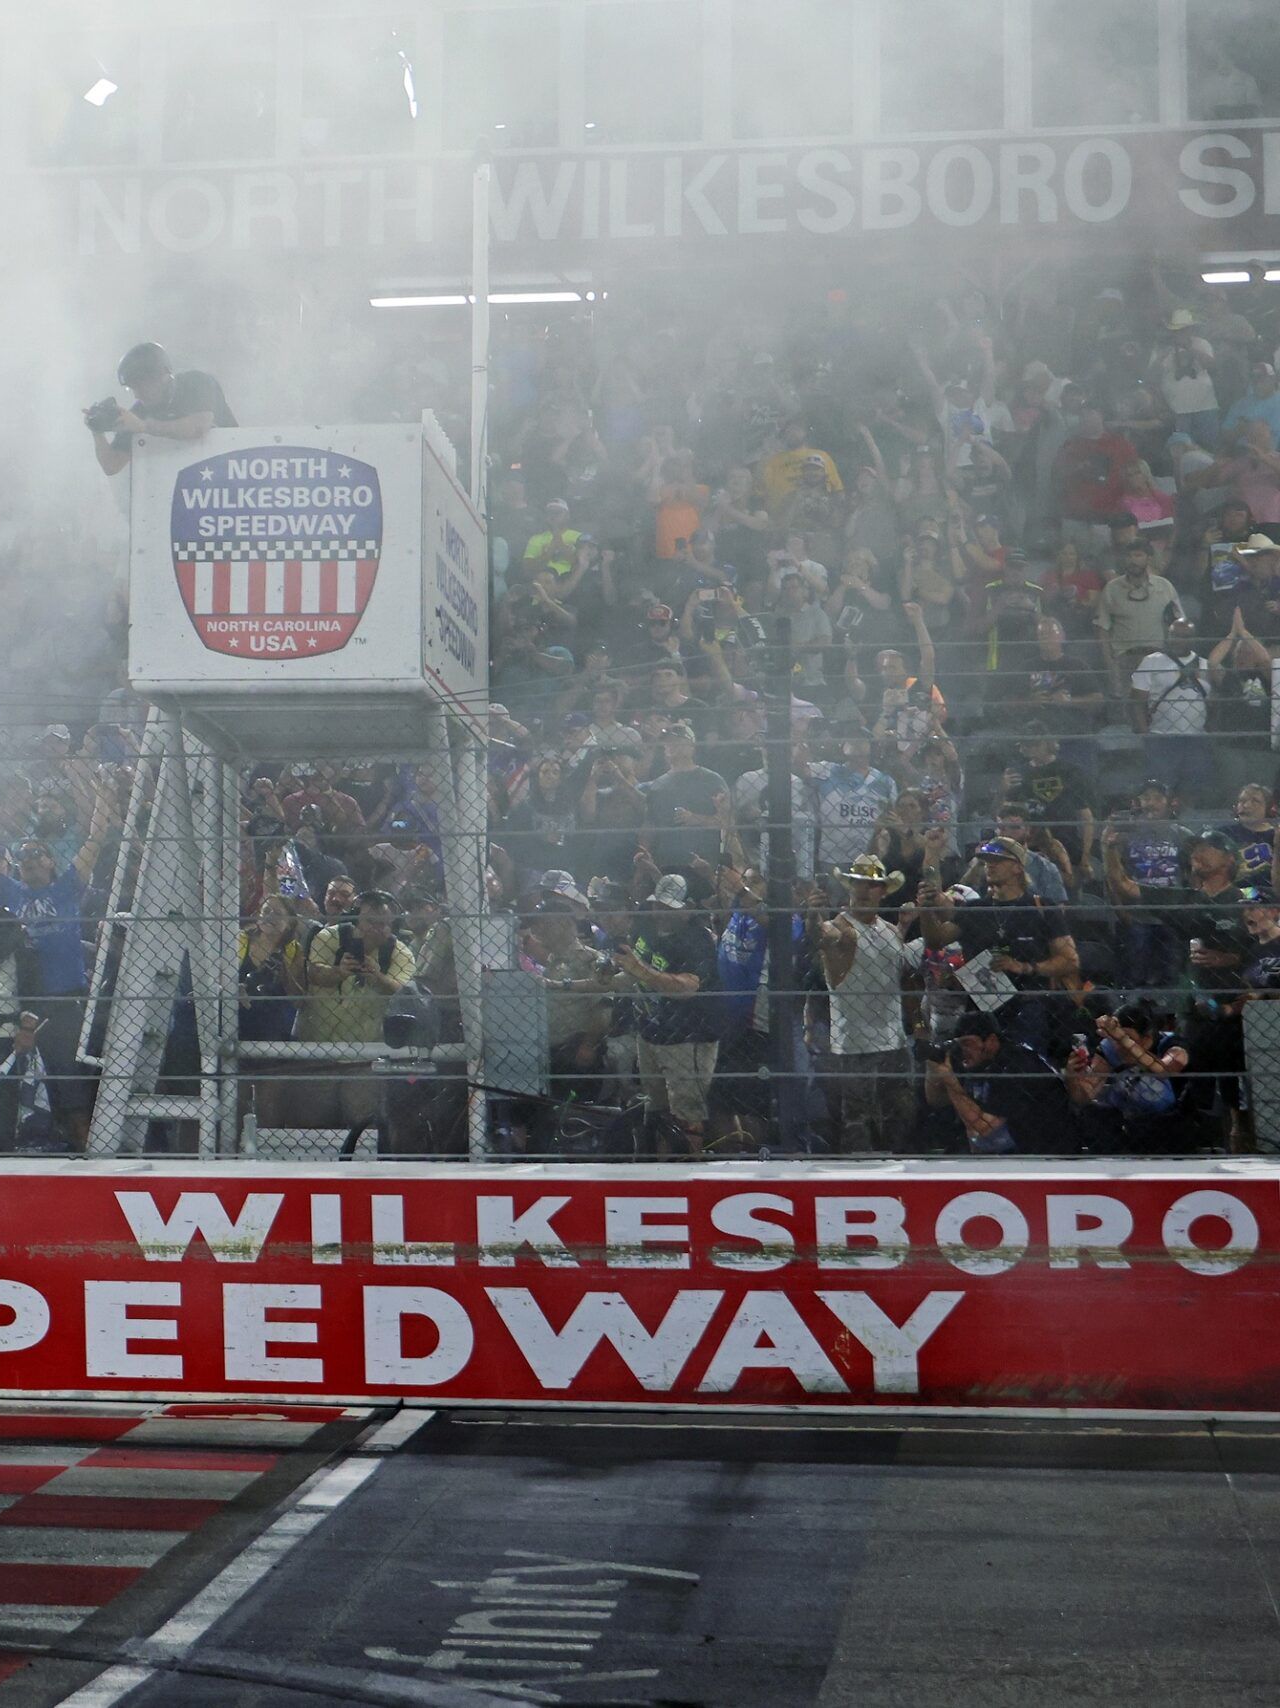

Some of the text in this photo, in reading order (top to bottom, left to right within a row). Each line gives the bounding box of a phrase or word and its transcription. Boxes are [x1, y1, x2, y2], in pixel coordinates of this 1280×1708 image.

[77, 160, 436, 257] NORTH
[486, 137, 1134, 244] WILKESBORO
[227, 458, 327, 481] NORTH
[181, 485, 373, 509] WILKESBORO
[198, 514, 356, 538] SPEEDWAY
[206, 620, 341, 632] NORTH CAROLINA
[250, 635, 297, 651] USA
[840, 803, 880, 820] BUSC
[114, 1190, 1261, 1277] WILKESBORO
